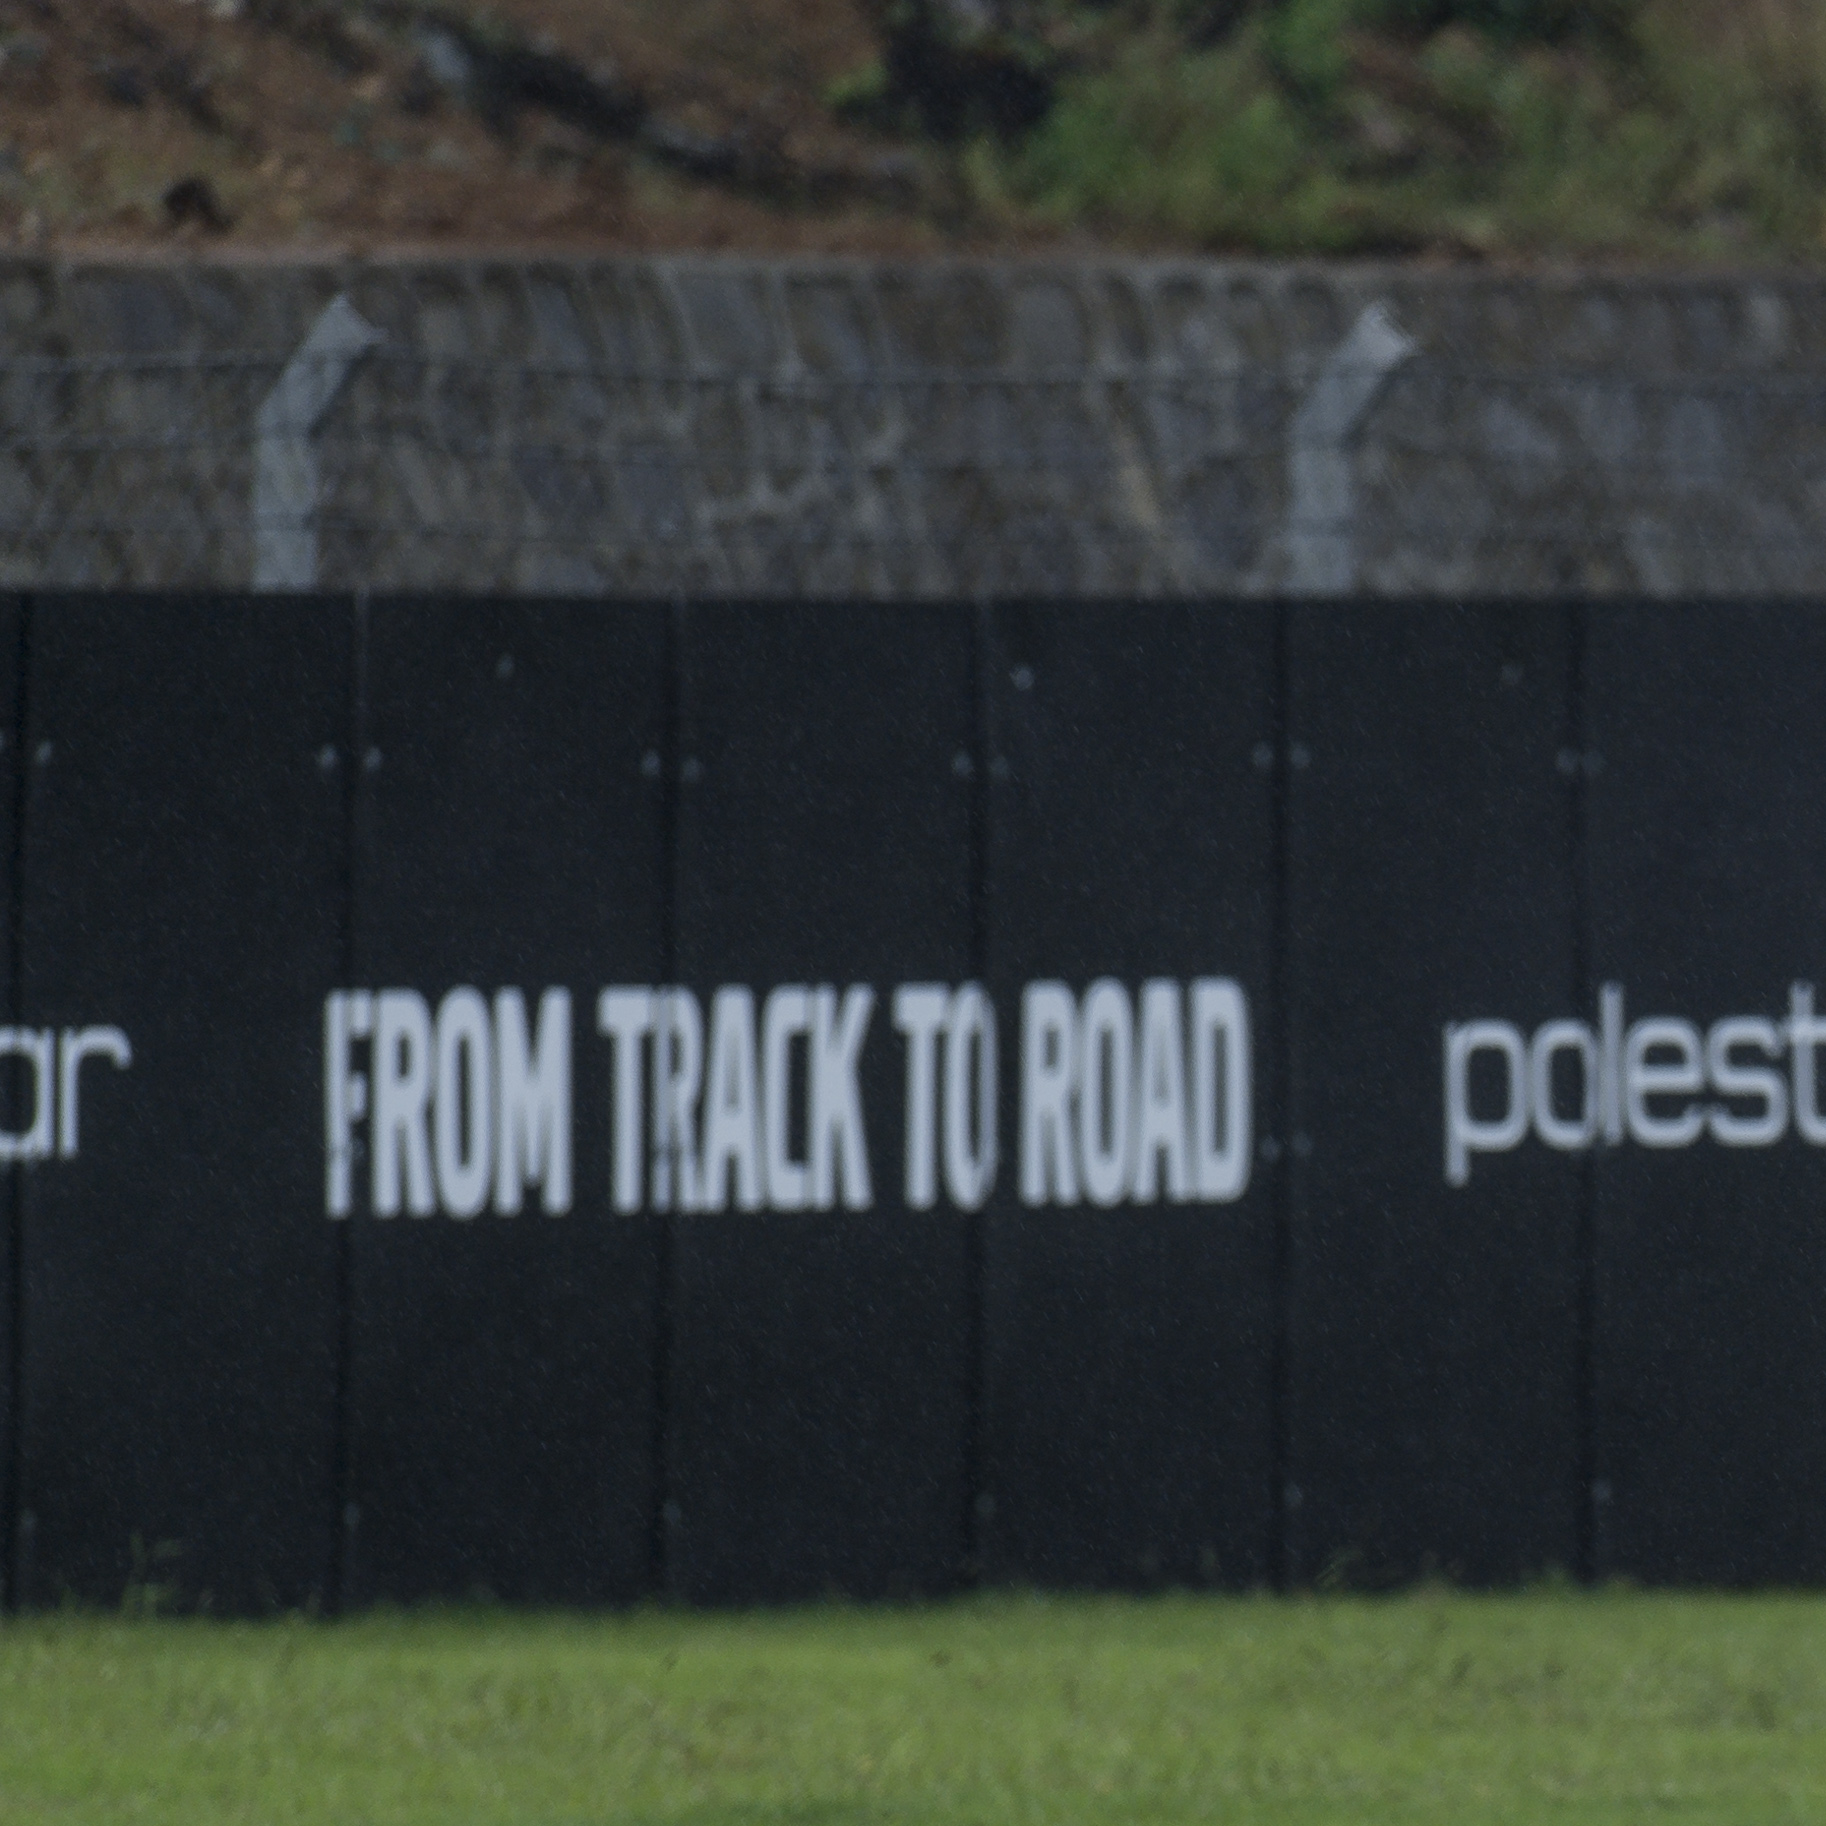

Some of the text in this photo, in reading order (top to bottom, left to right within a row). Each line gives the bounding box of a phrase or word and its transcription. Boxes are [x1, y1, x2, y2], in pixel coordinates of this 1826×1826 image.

[324, 977, 1251, 1219] FROM TRACK TO ROAD
